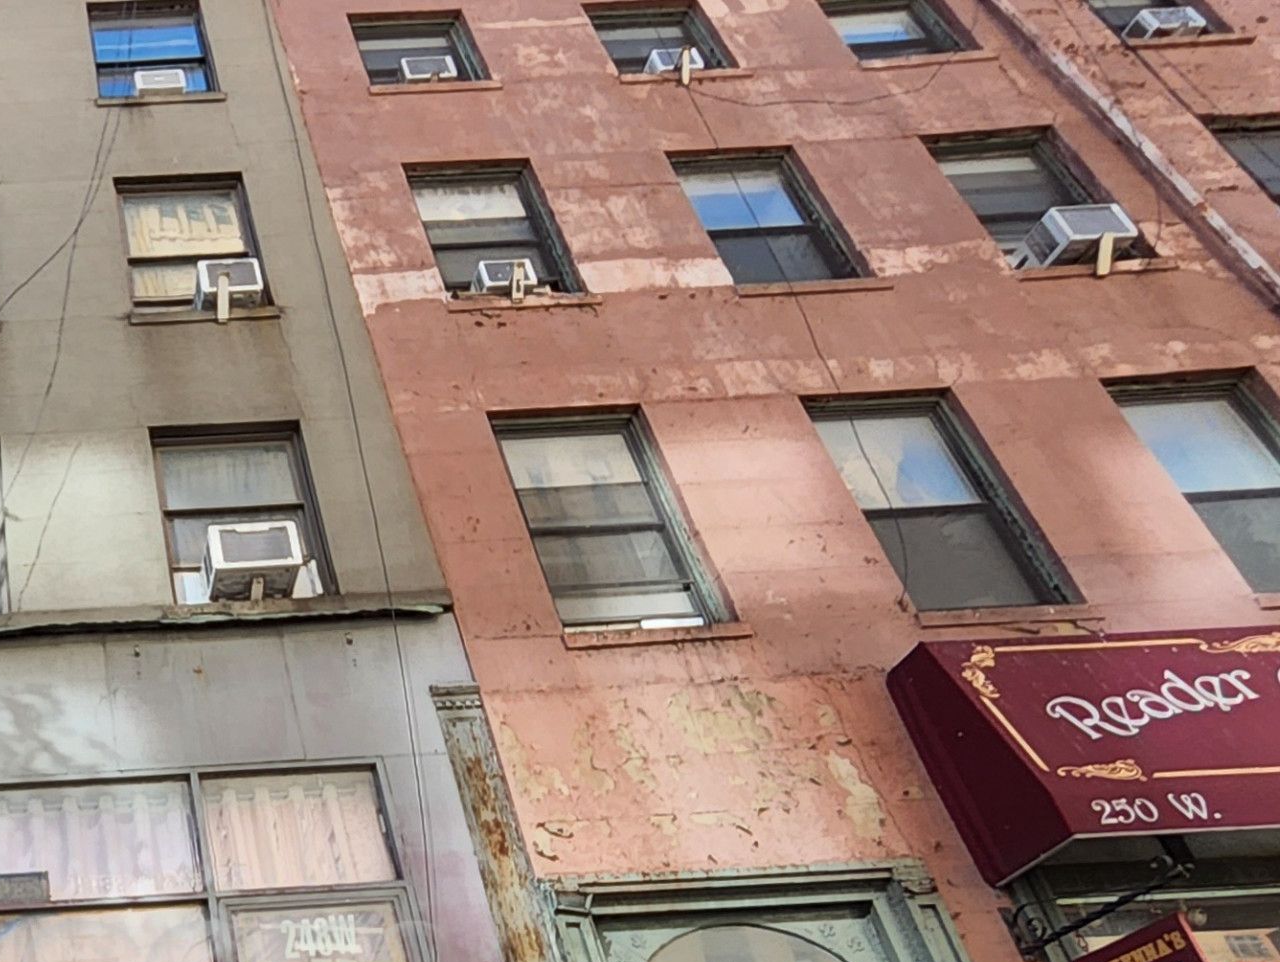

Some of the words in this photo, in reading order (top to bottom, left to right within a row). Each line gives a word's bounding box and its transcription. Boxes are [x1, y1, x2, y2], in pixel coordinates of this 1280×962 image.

[1046, 669, 1260, 740] Reader
[1091, 797, 1159, 825] 250
[1167, 792, 1222, 820] W.
